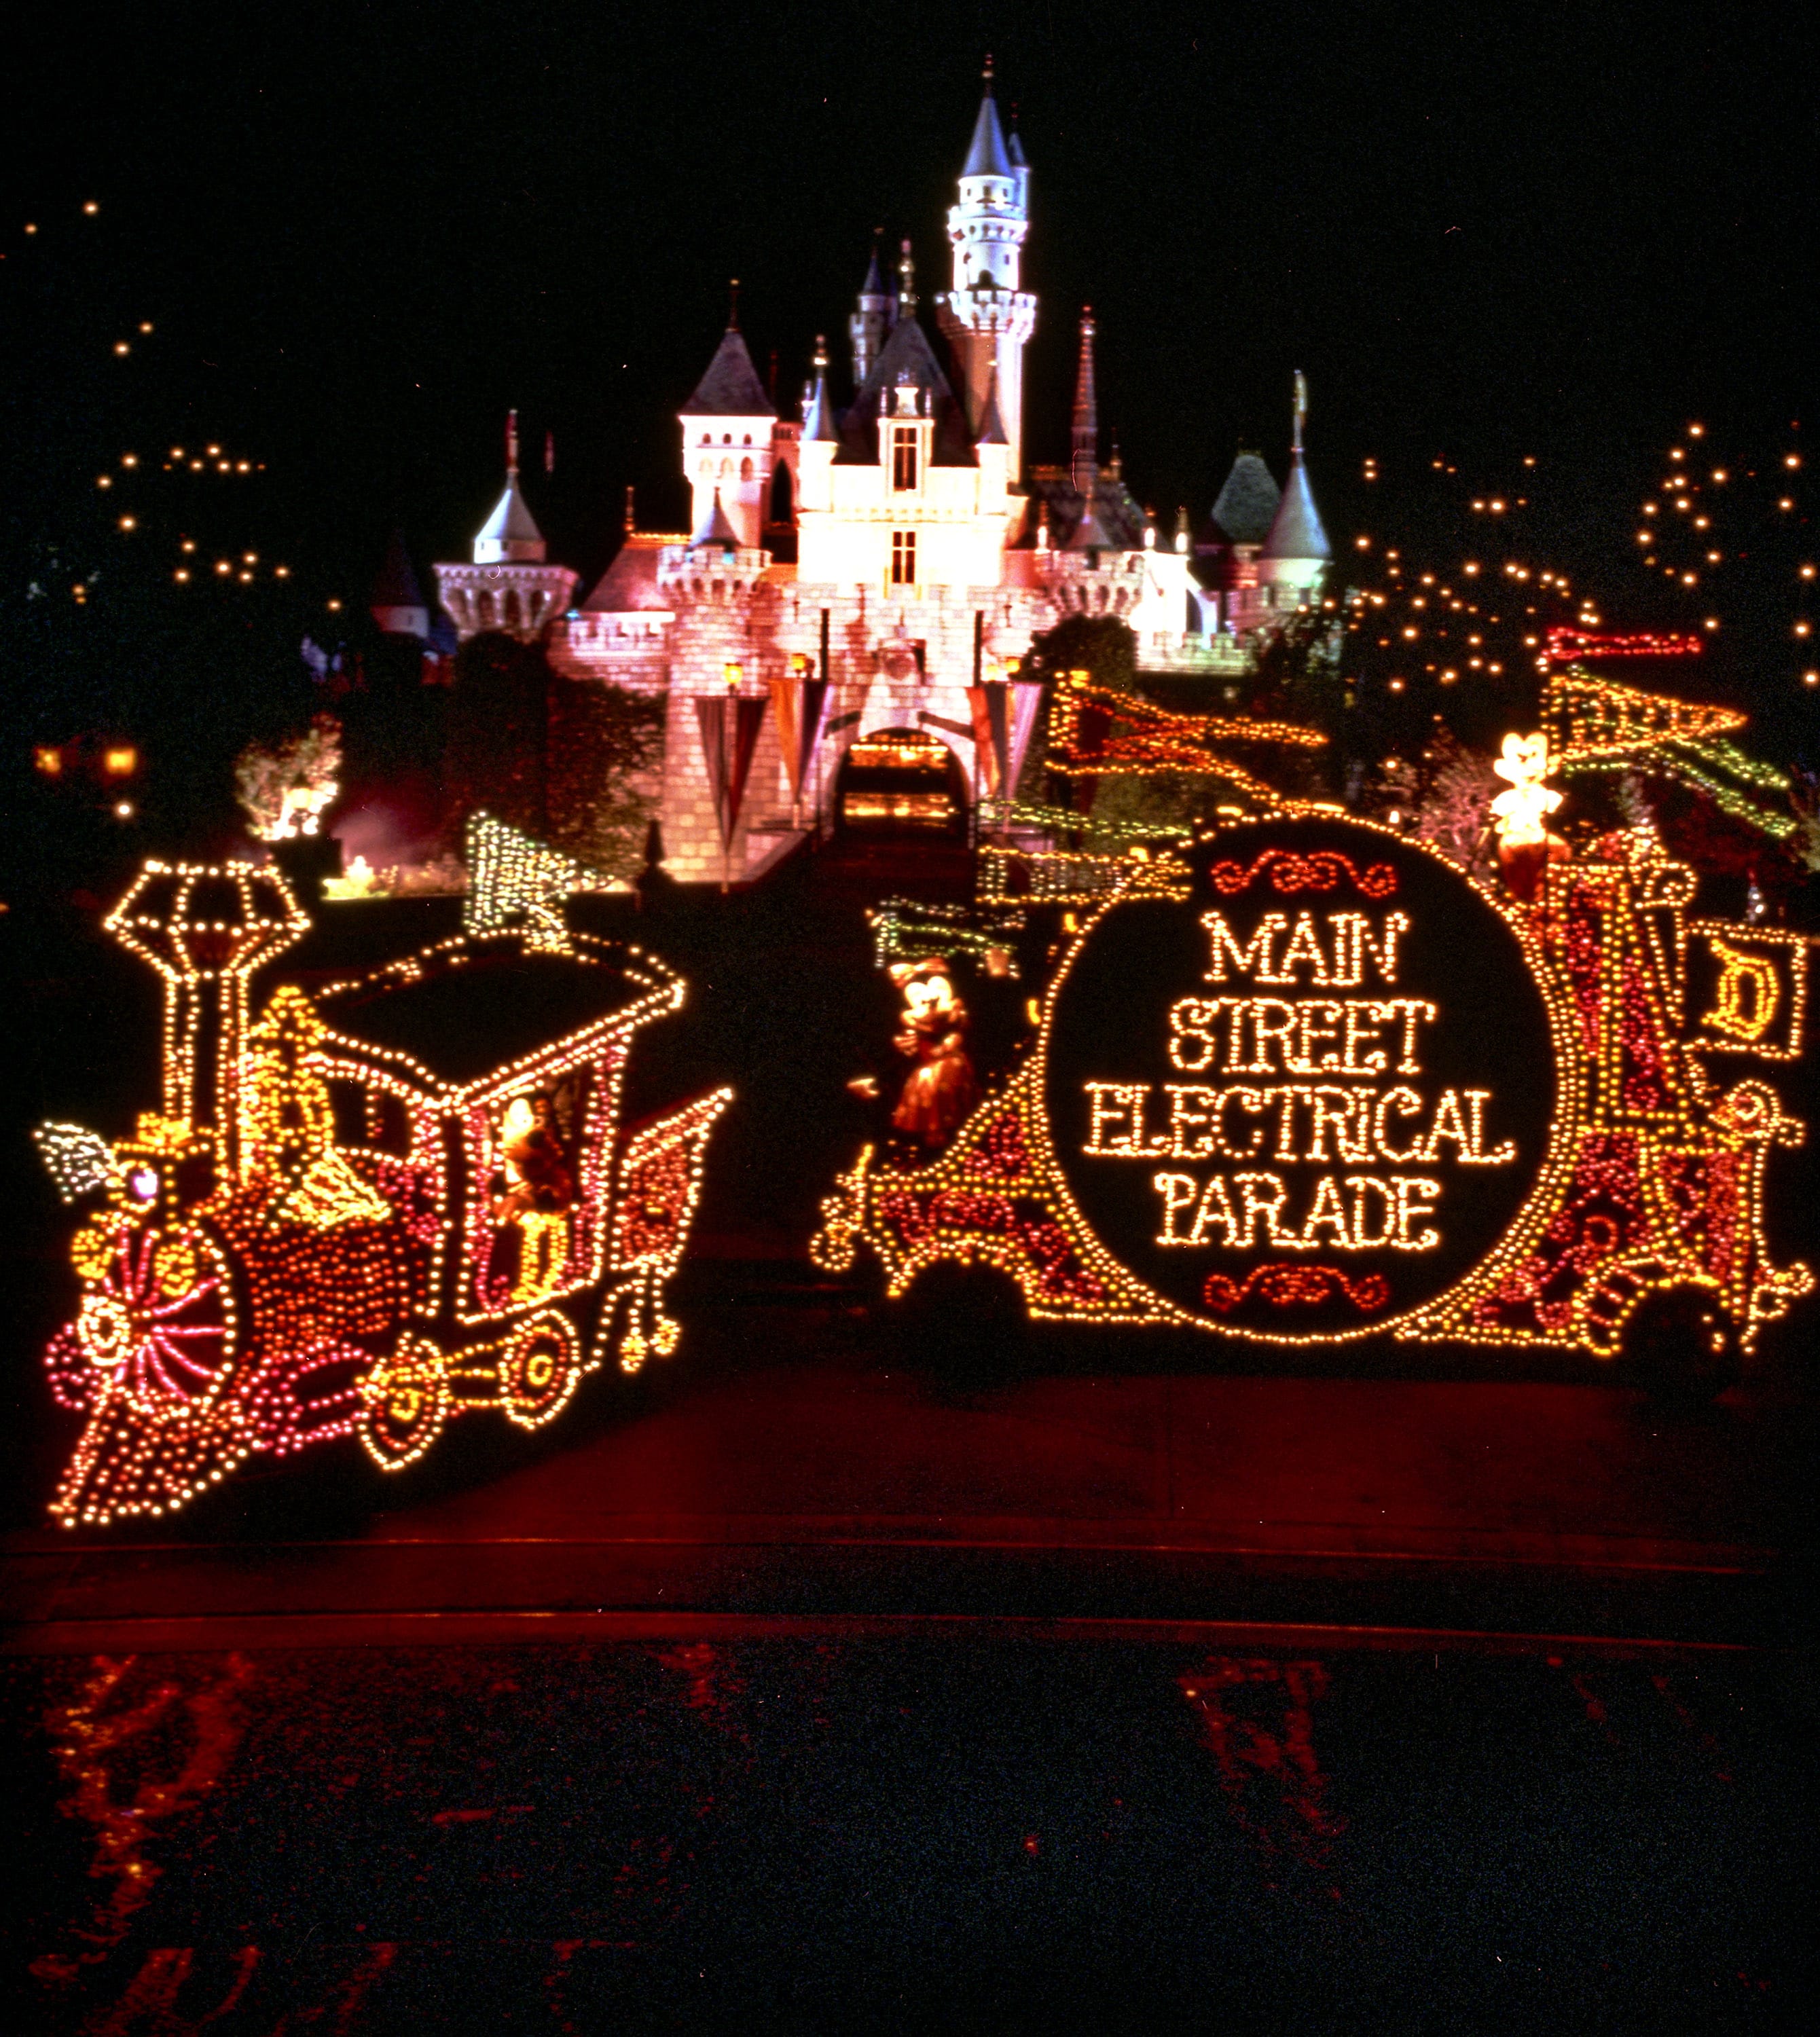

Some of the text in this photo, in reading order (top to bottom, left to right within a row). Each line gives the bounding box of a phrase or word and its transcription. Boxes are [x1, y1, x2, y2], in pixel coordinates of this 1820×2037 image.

[1200, 911, 1410, 988] MAIN
[1169, 996, 1438, 1075] STREET
[1082, 1081, 1517, 1164] ELECTRICAL
[1153, 1171, 1442, 1252] PARADE
